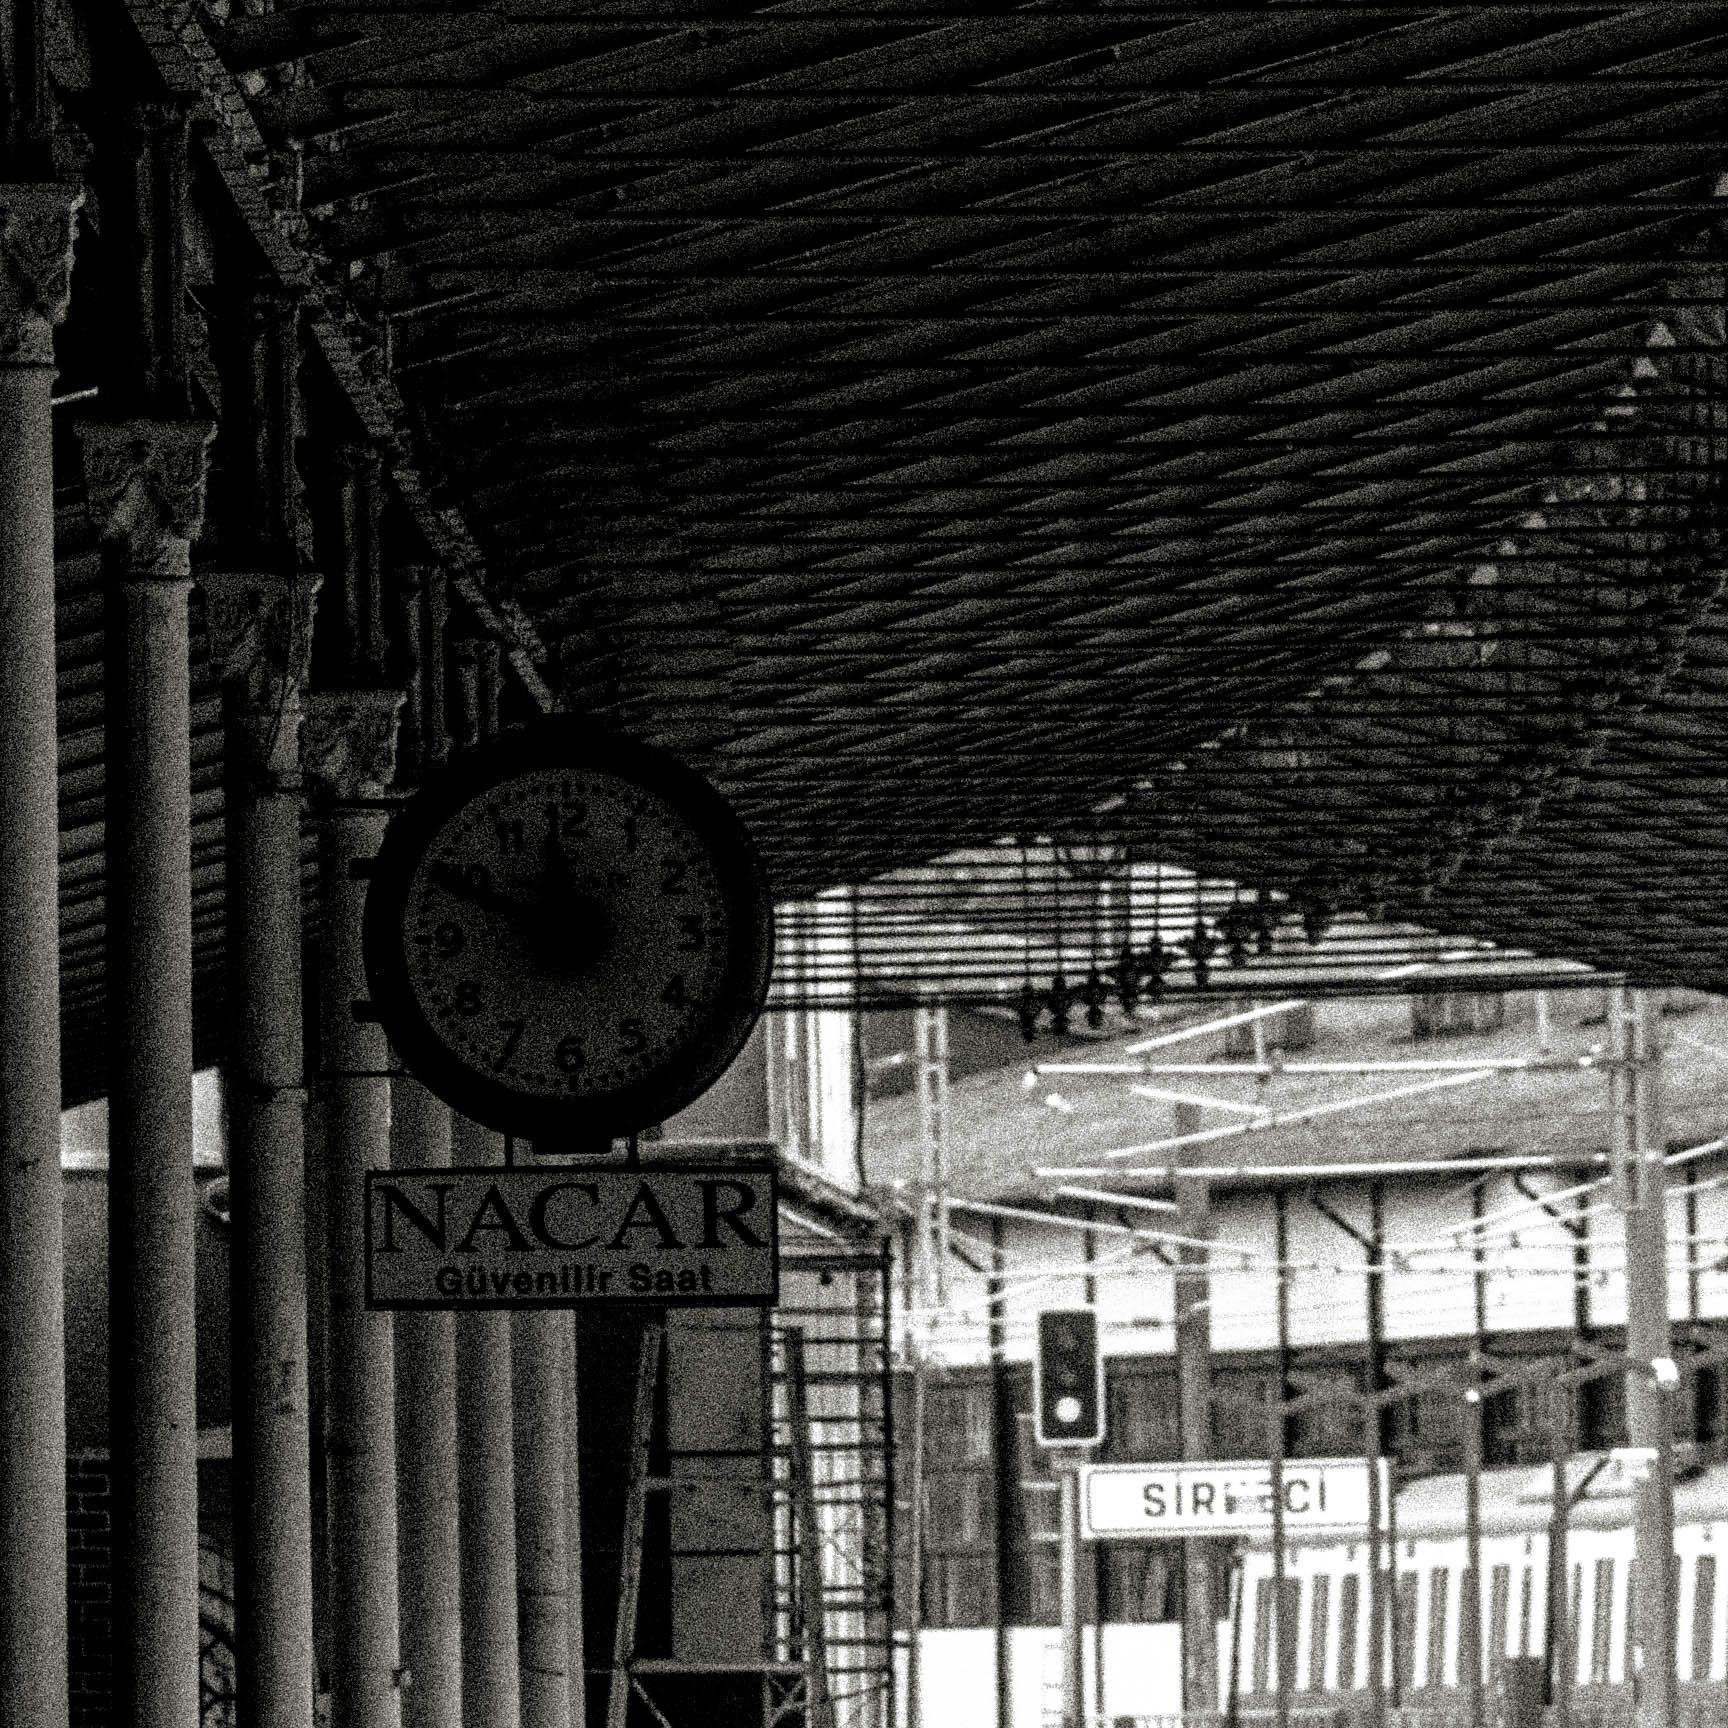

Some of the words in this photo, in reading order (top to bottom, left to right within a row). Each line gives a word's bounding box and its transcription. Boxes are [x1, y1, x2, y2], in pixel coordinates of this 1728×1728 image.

[496, 818, 525, 855] 11
[623, 816, 638, 854] 1
[661, 859, 688, 895] 2
[434, 921, 466, 960] 9
[677, 914, 705, 951] 3
[454, 980, 484, 1017] 8
[659, 974, 687, 1009] 4
[497, 1020, 526, 1059] 7
[555, 1035, 585, 1073] 6
[618, 1018, 648, 1055] 5
[374, 1180, 770, 1253] NACAR
[436, 1264, 612, 1295] Güvenilir
[630, 1263, 713, 1293] Saat
